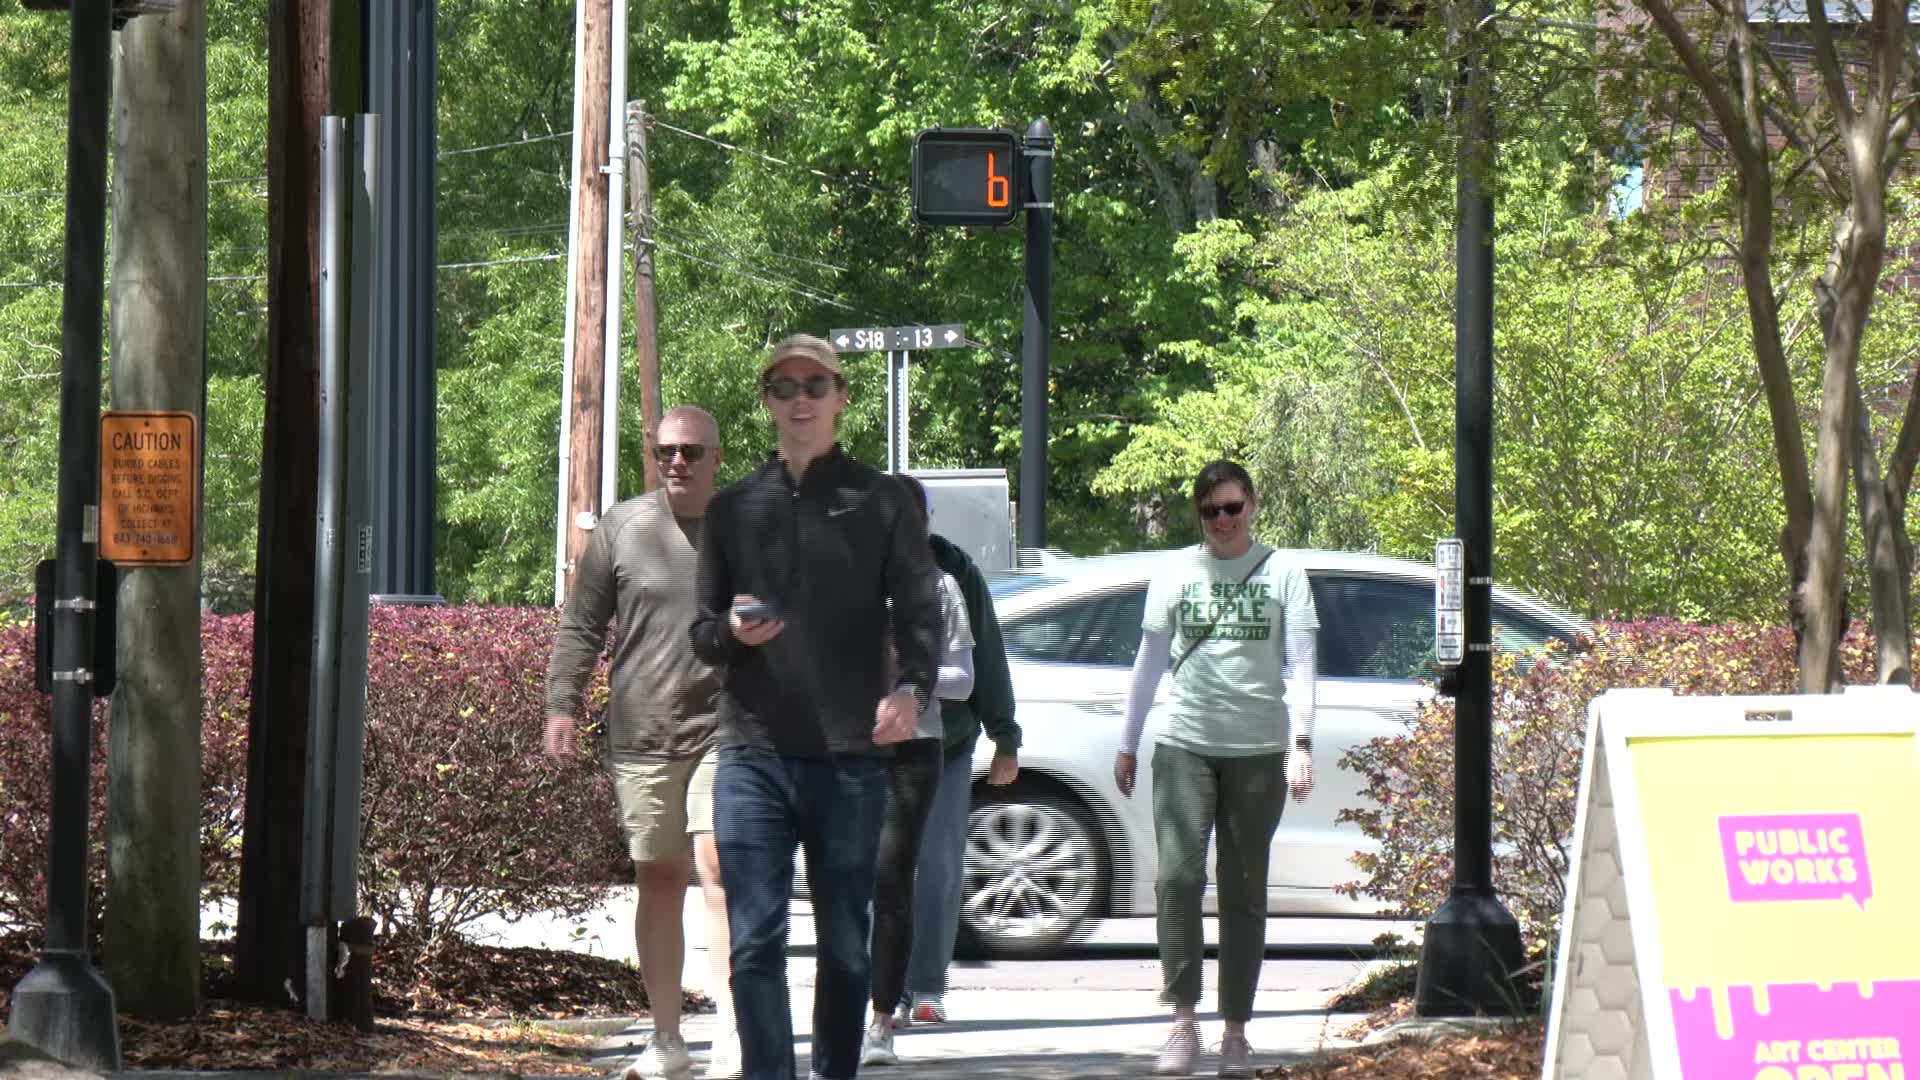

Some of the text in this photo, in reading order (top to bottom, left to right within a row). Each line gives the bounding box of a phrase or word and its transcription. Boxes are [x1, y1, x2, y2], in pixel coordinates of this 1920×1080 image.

[112, 432, 181, 450] CAUTION
[147, 459, 181, 469] CABLES
[111, 474, 145, 484] BEFORE
[112, 488, 131, 499] CALL
[121, 519, 158, 528] COLLECT
[1210, 583, 1271, 599] SERVE
[1735, 828, 1849, 855] PUBLIC
[1738, 857, 1857, 884] WORKS
[1755, 1038, 1901, 1063] ART CENTER
